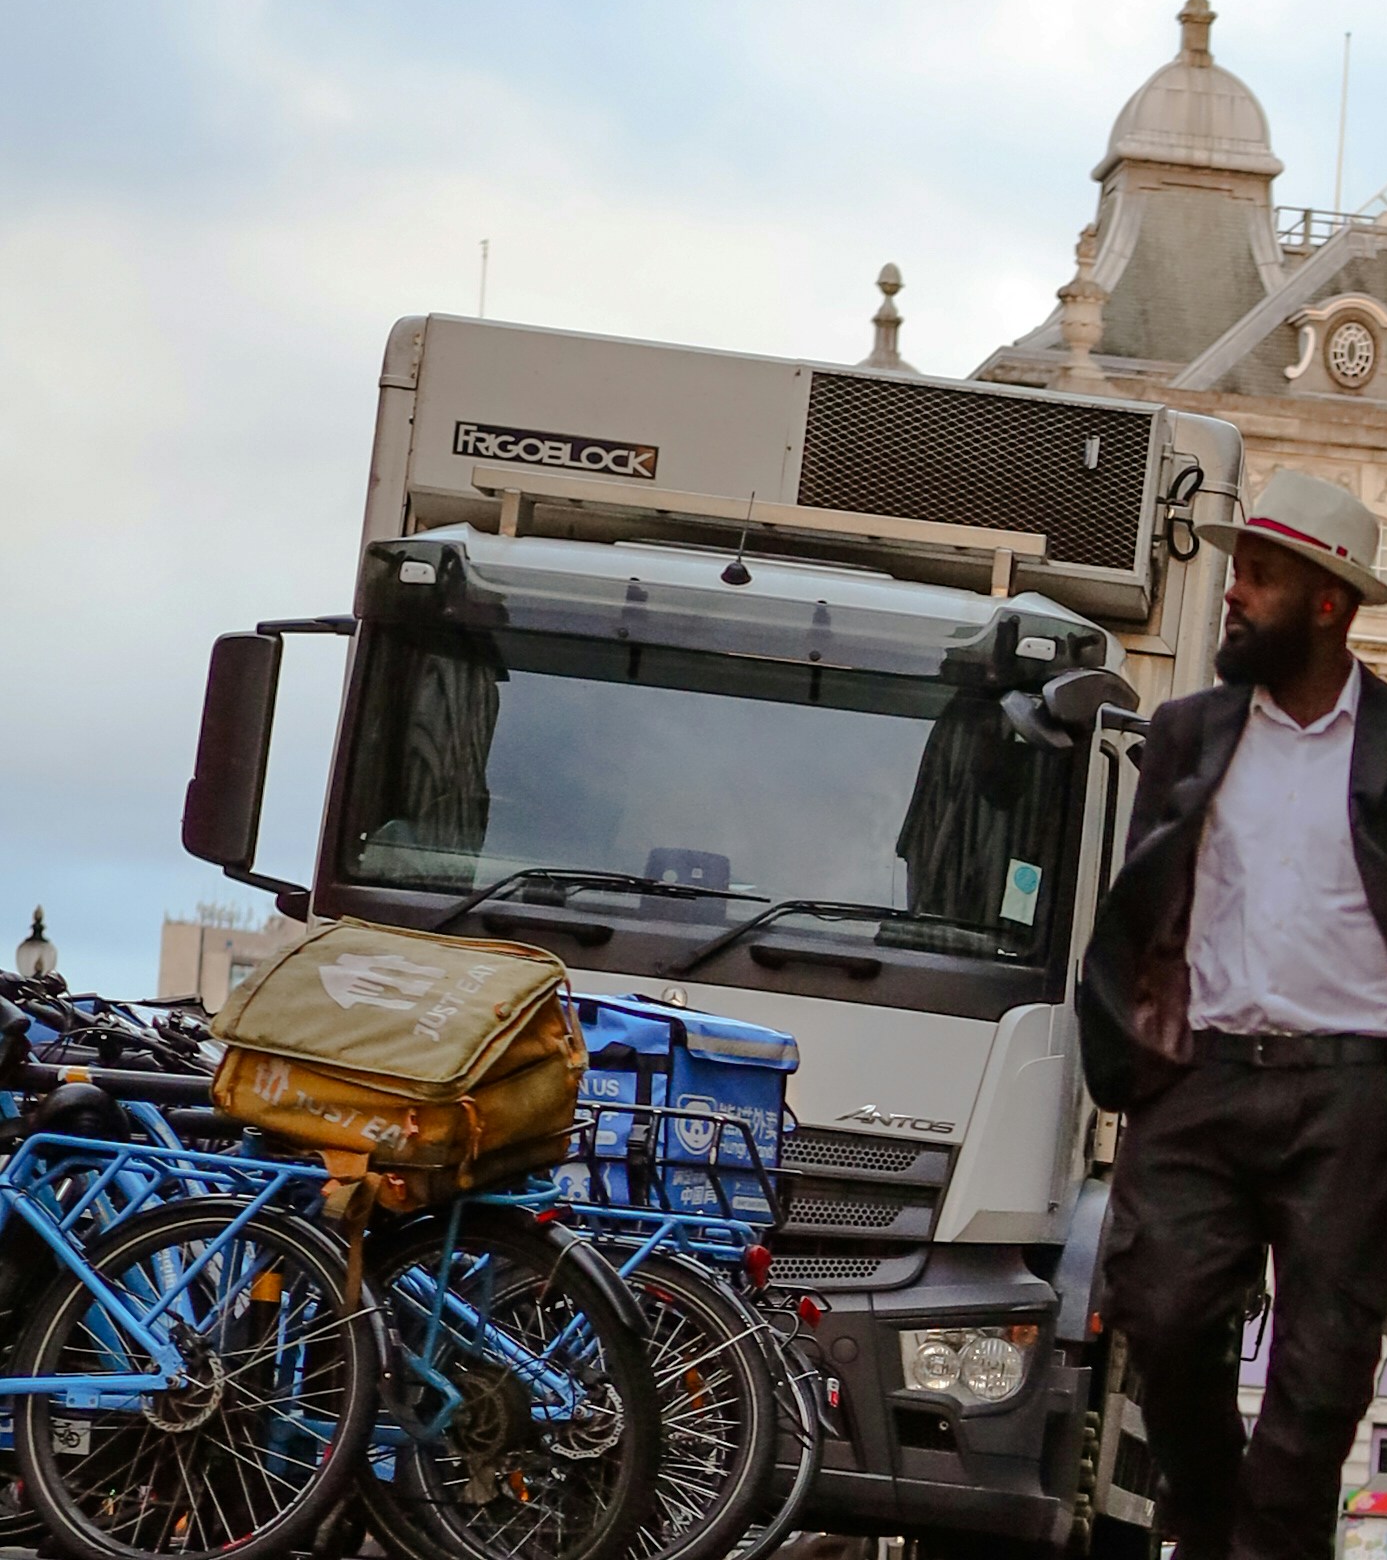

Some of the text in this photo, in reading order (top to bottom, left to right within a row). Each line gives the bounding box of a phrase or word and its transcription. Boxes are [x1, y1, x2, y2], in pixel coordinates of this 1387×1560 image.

[456, 424, 653, 477] FRIGOBLOCK
[412, 994, 460, 1041] JUST
[294, 1090, 362, 1128] JUST
[592, 1079, 620, 1097] US
